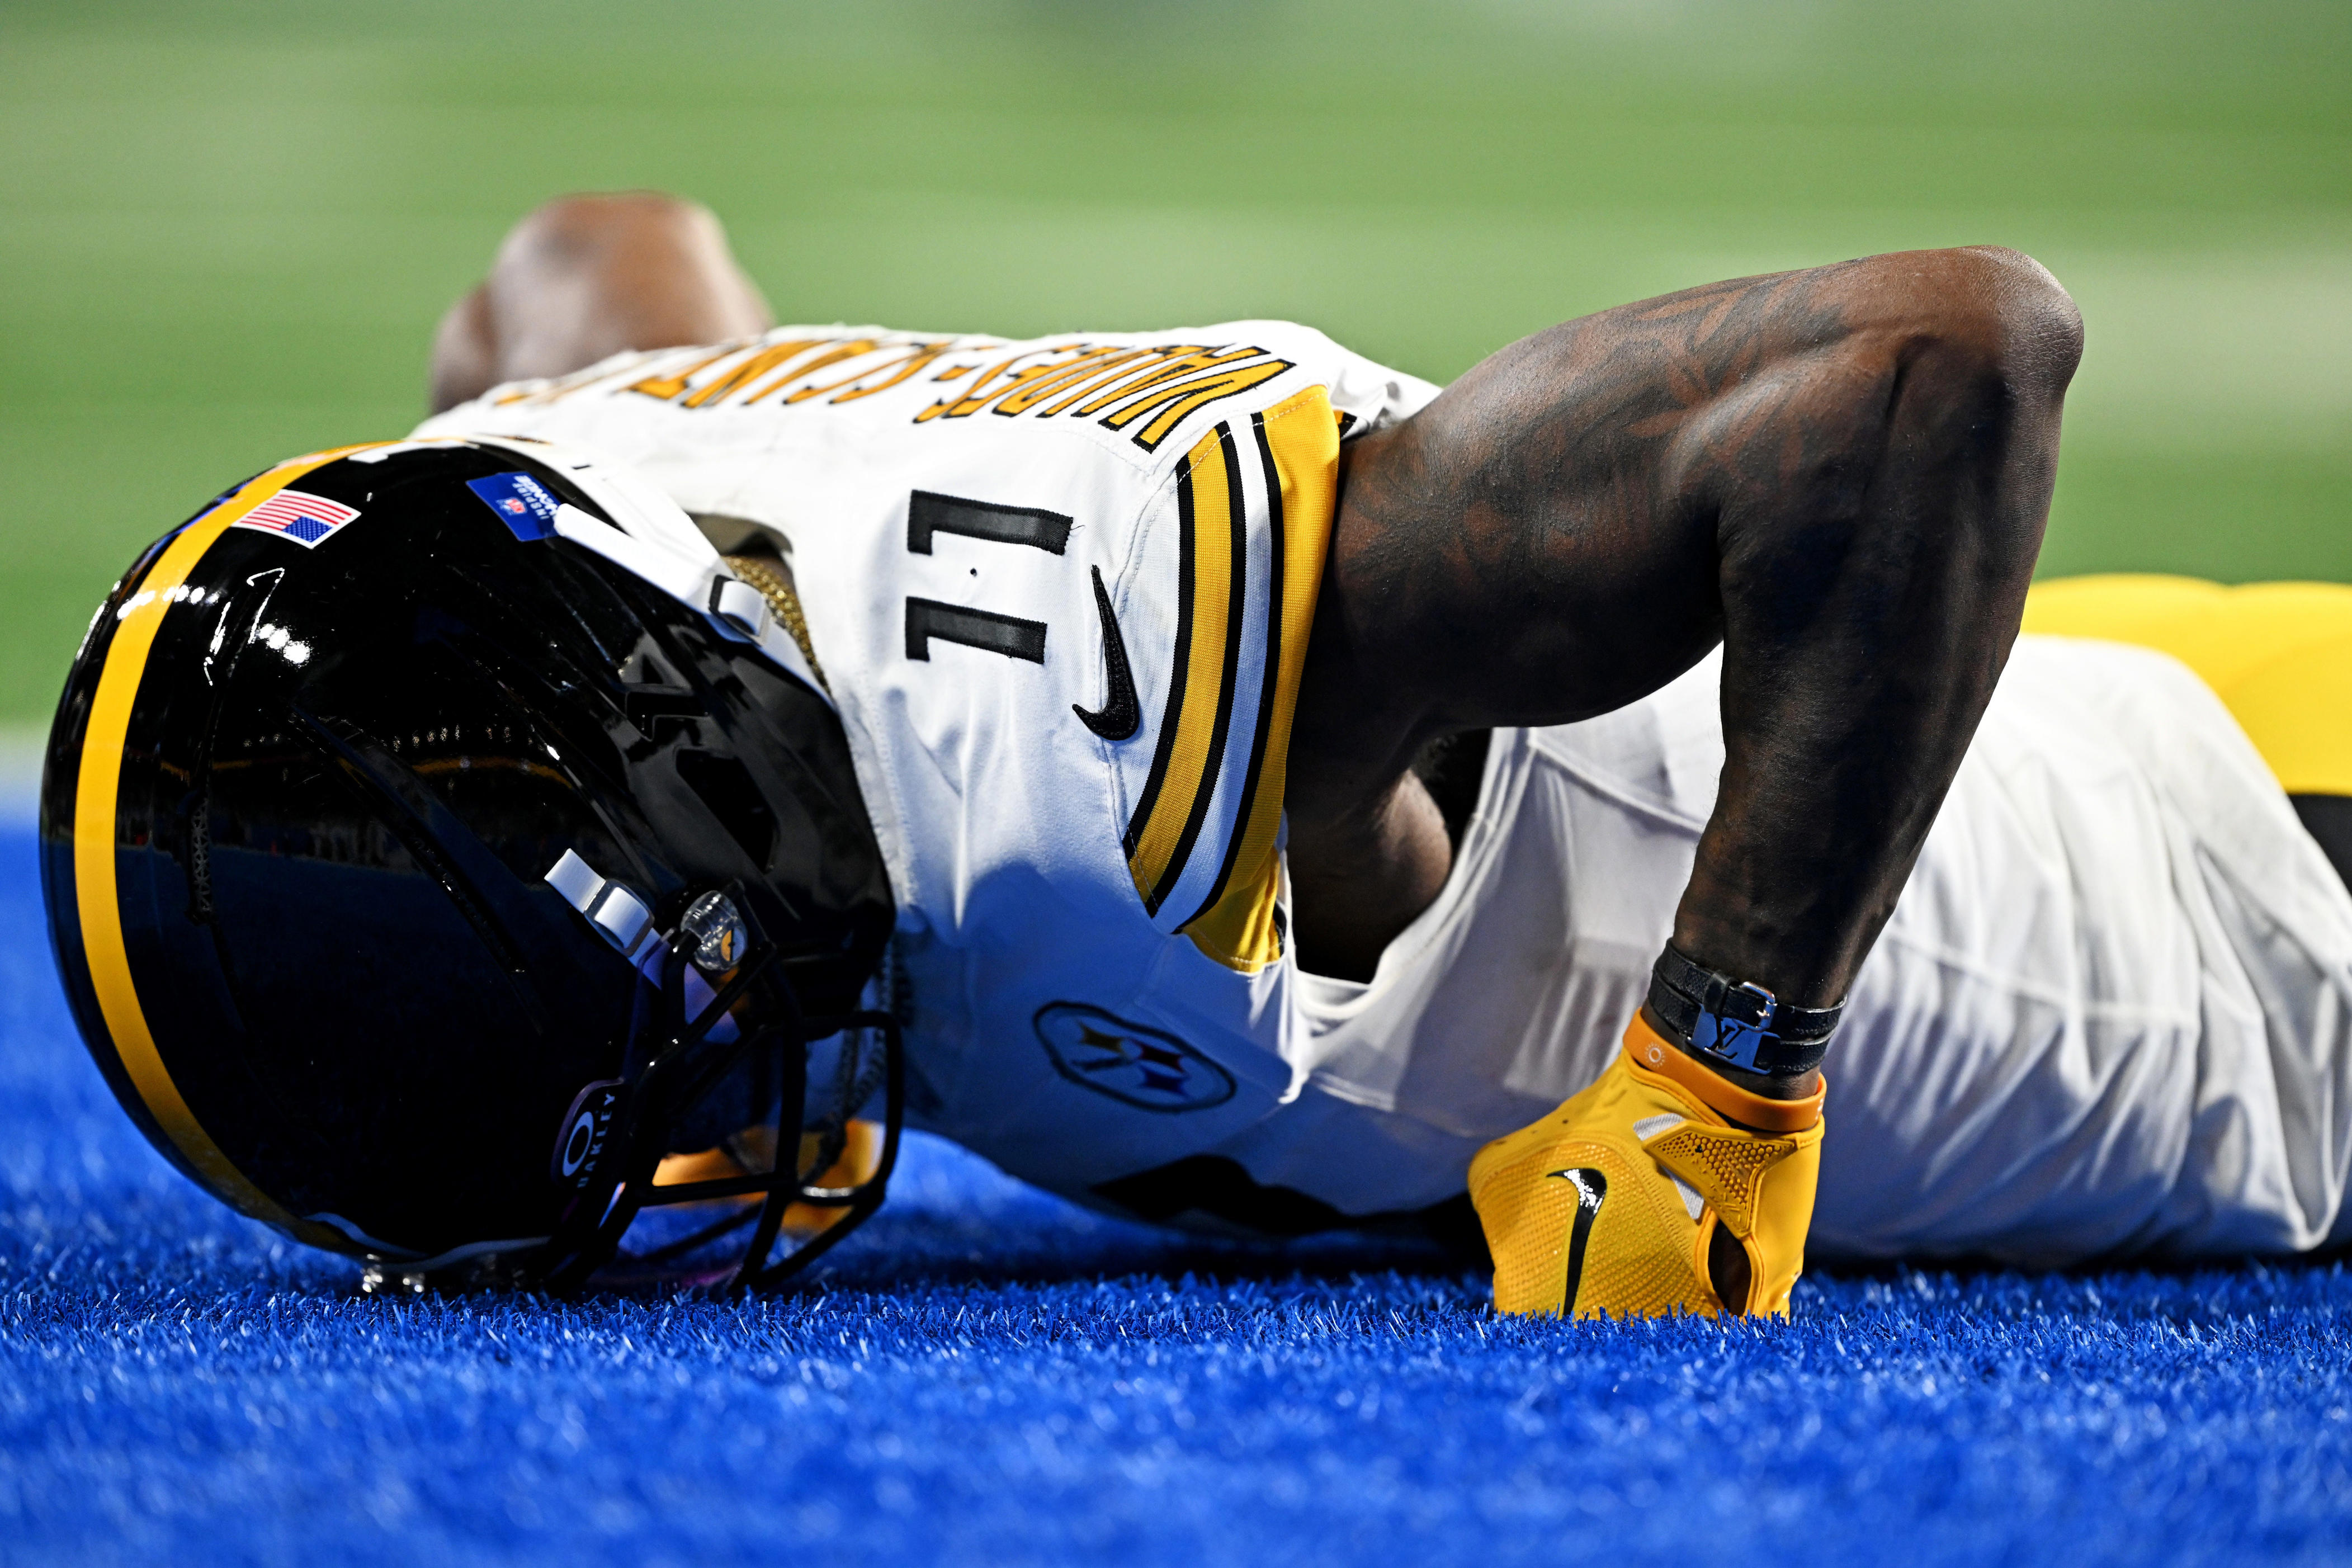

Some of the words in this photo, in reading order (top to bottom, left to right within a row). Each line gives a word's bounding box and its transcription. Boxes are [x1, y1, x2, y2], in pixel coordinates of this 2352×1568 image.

[513, 475, 558, 516] HANGE
[904, 489, 1074, 665] 11
[578, 1094, 615, 1188] OAKLEY
